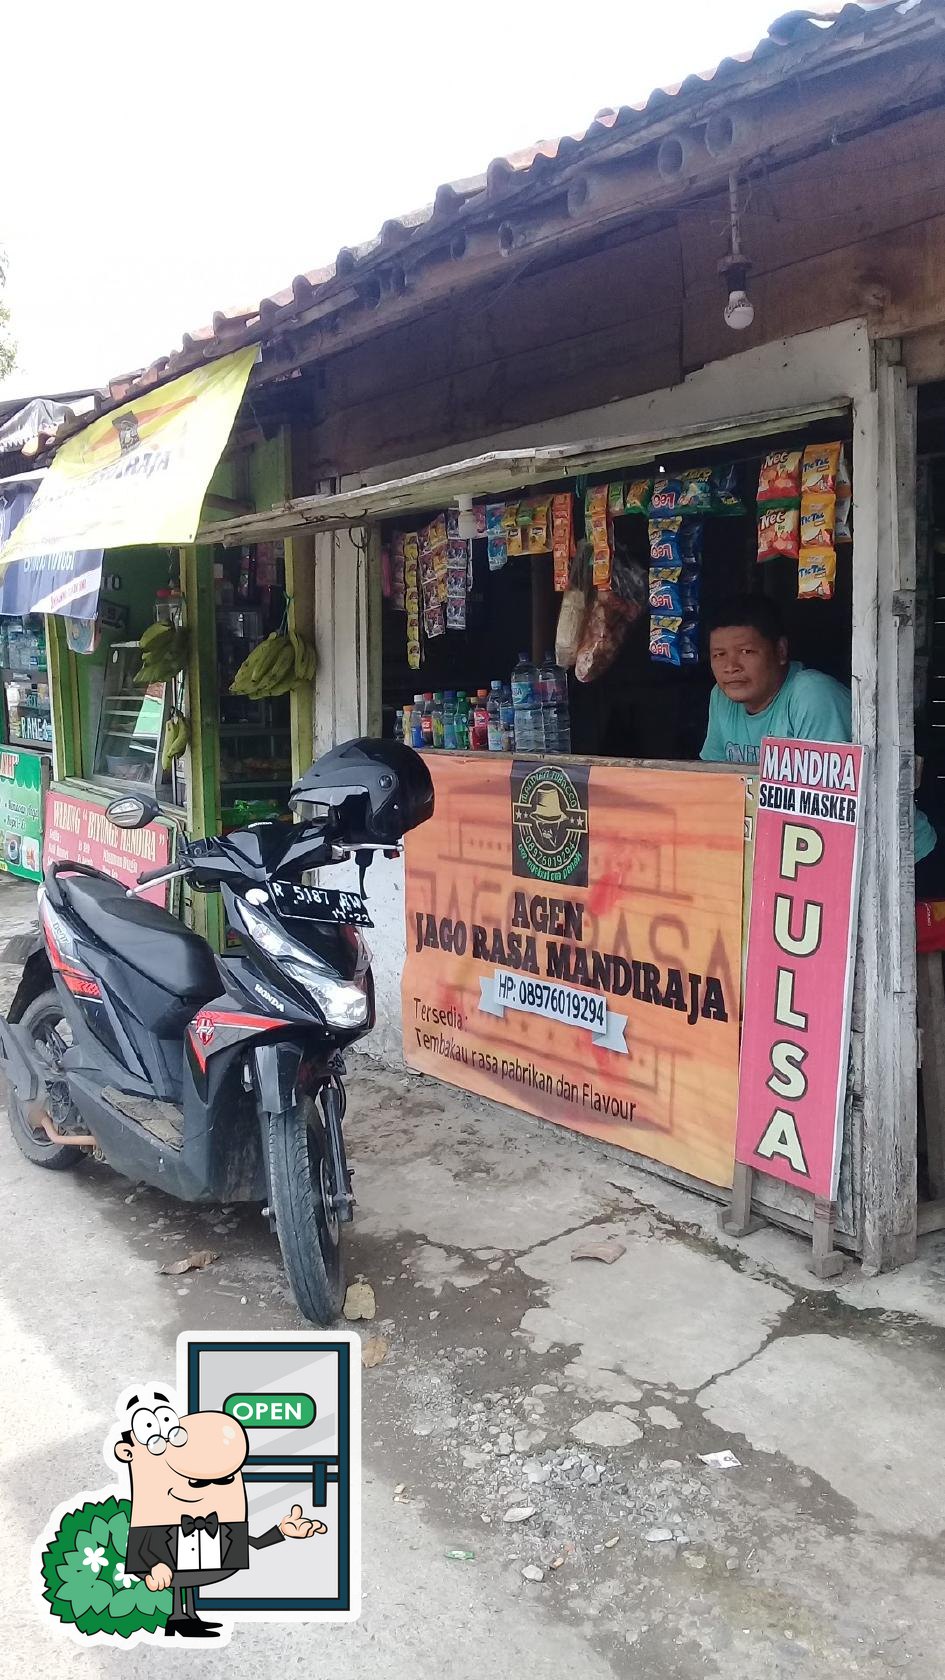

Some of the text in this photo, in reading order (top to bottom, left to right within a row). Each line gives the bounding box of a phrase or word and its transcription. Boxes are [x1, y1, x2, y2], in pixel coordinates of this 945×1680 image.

[760, 512, 786, 531] Net
[762, 743, 857, 792] MANDIRA
[759, 783, 857, 823] SEDIA MASKER
[272, 882, 285, 898] R
[511, 890, 584, 941] AGEN
[416, 912, 728, 1025] JAGO RASA MANDIRAJA
[254, 983, 285, 1013] HONDA
[498, 975, 604, 1026] HP: 08976019294
[754, 820, 825, 1178] PULSA
[414, 1027, 637, 1122] Tembakau rasa pabrikan dan Flavour
